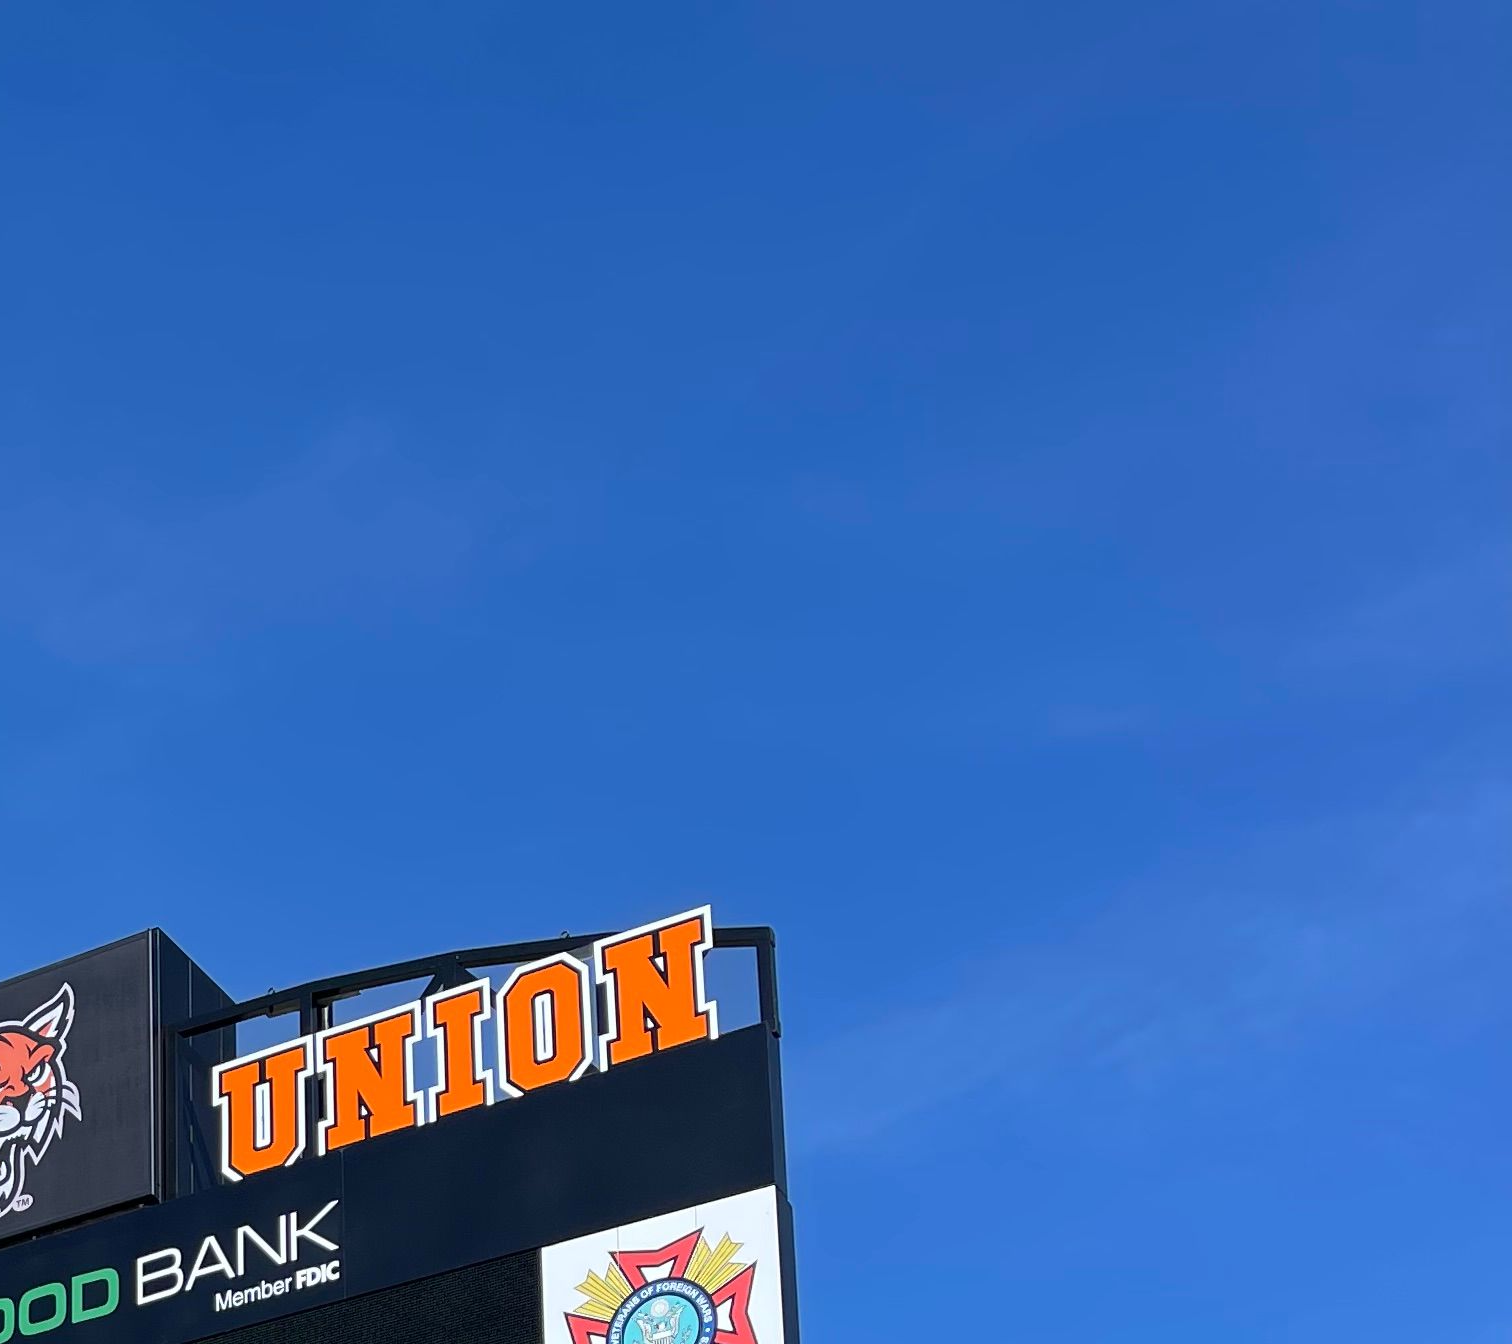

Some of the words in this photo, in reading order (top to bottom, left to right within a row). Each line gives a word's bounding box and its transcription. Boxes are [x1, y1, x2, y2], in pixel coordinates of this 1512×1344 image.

[212, 904, 719, 1182] UNION
[16, 1197, 30, 1208] TM
[136, 1200, 340, 1305] BANK
[215, 1276, 292, 1312] Member
[295, 1260, 340, 1290] FDIC
[640, 1286, 655, 1298] OF
[656, 1282, 700, 1299] FOREIGN
[695, 1294, 713, 1323] WARS
